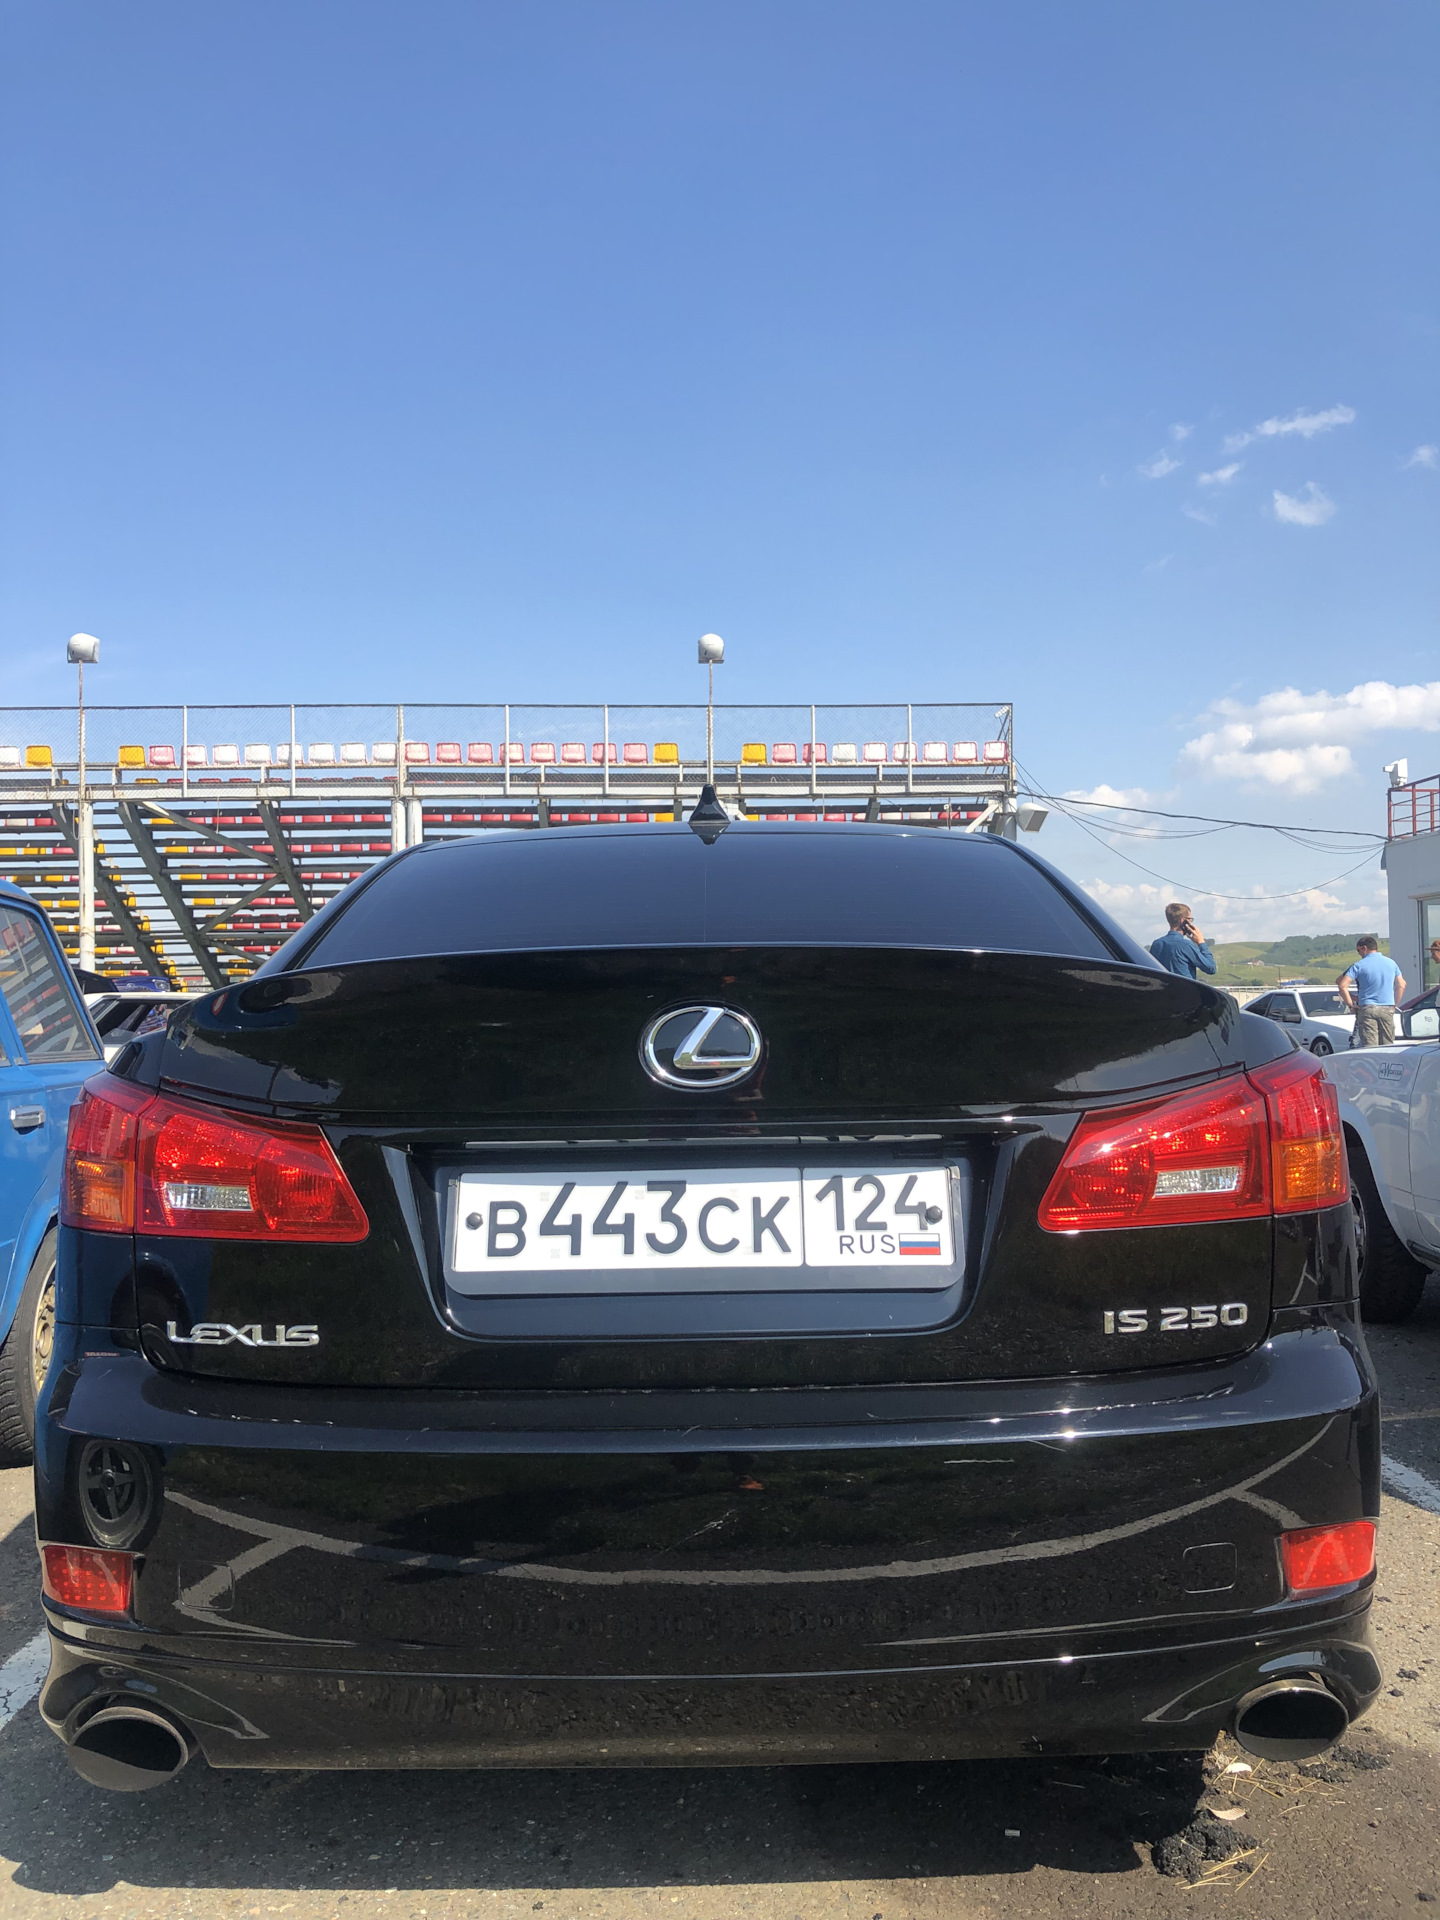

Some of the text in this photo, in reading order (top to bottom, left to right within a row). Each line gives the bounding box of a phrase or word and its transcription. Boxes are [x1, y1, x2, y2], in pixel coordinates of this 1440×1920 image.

[814, 1175, 927, 1231] 124
[839, 1234, 896, 1255] RUS
[166, 1320, 320, 1347] LEXUS
[1103, 1302, 1248, 1335] IS 250
